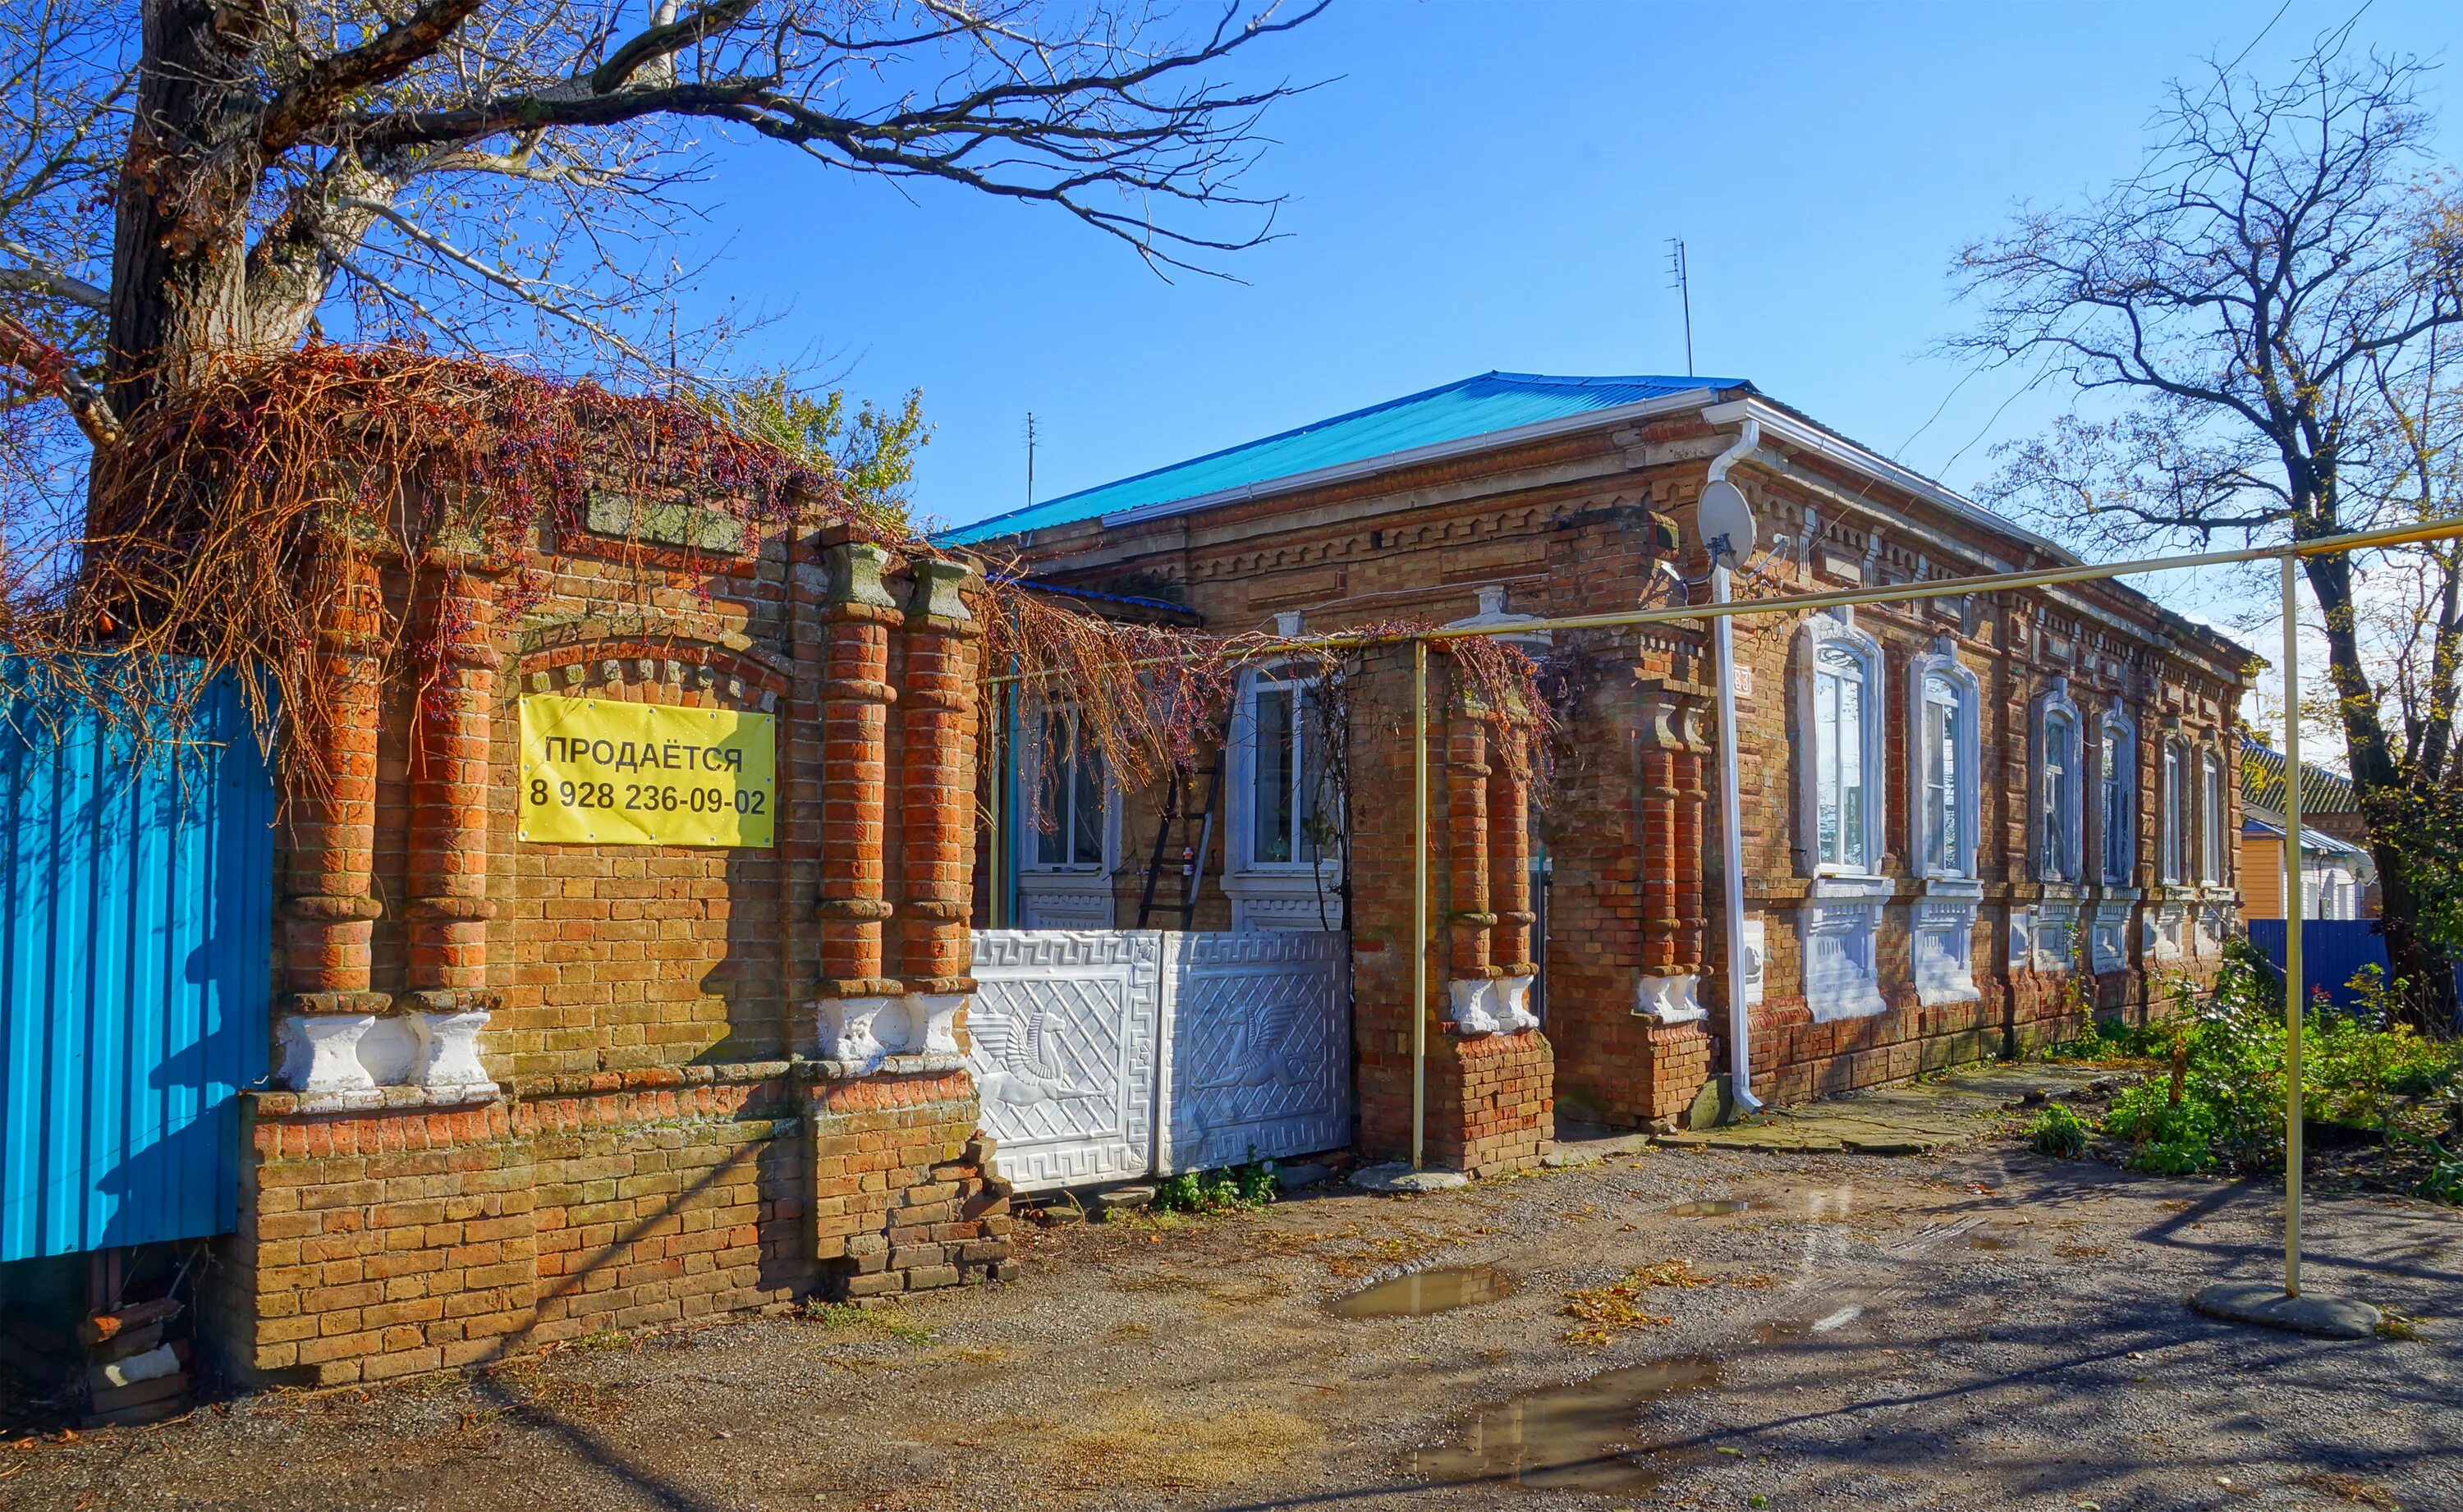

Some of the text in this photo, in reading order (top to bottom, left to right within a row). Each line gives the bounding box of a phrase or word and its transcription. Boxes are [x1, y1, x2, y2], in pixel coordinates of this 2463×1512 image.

[545, 735, 742, 773] ПРОДАЁТСЯ
[530, 779, 765, 815] 8 928 236-09-02
